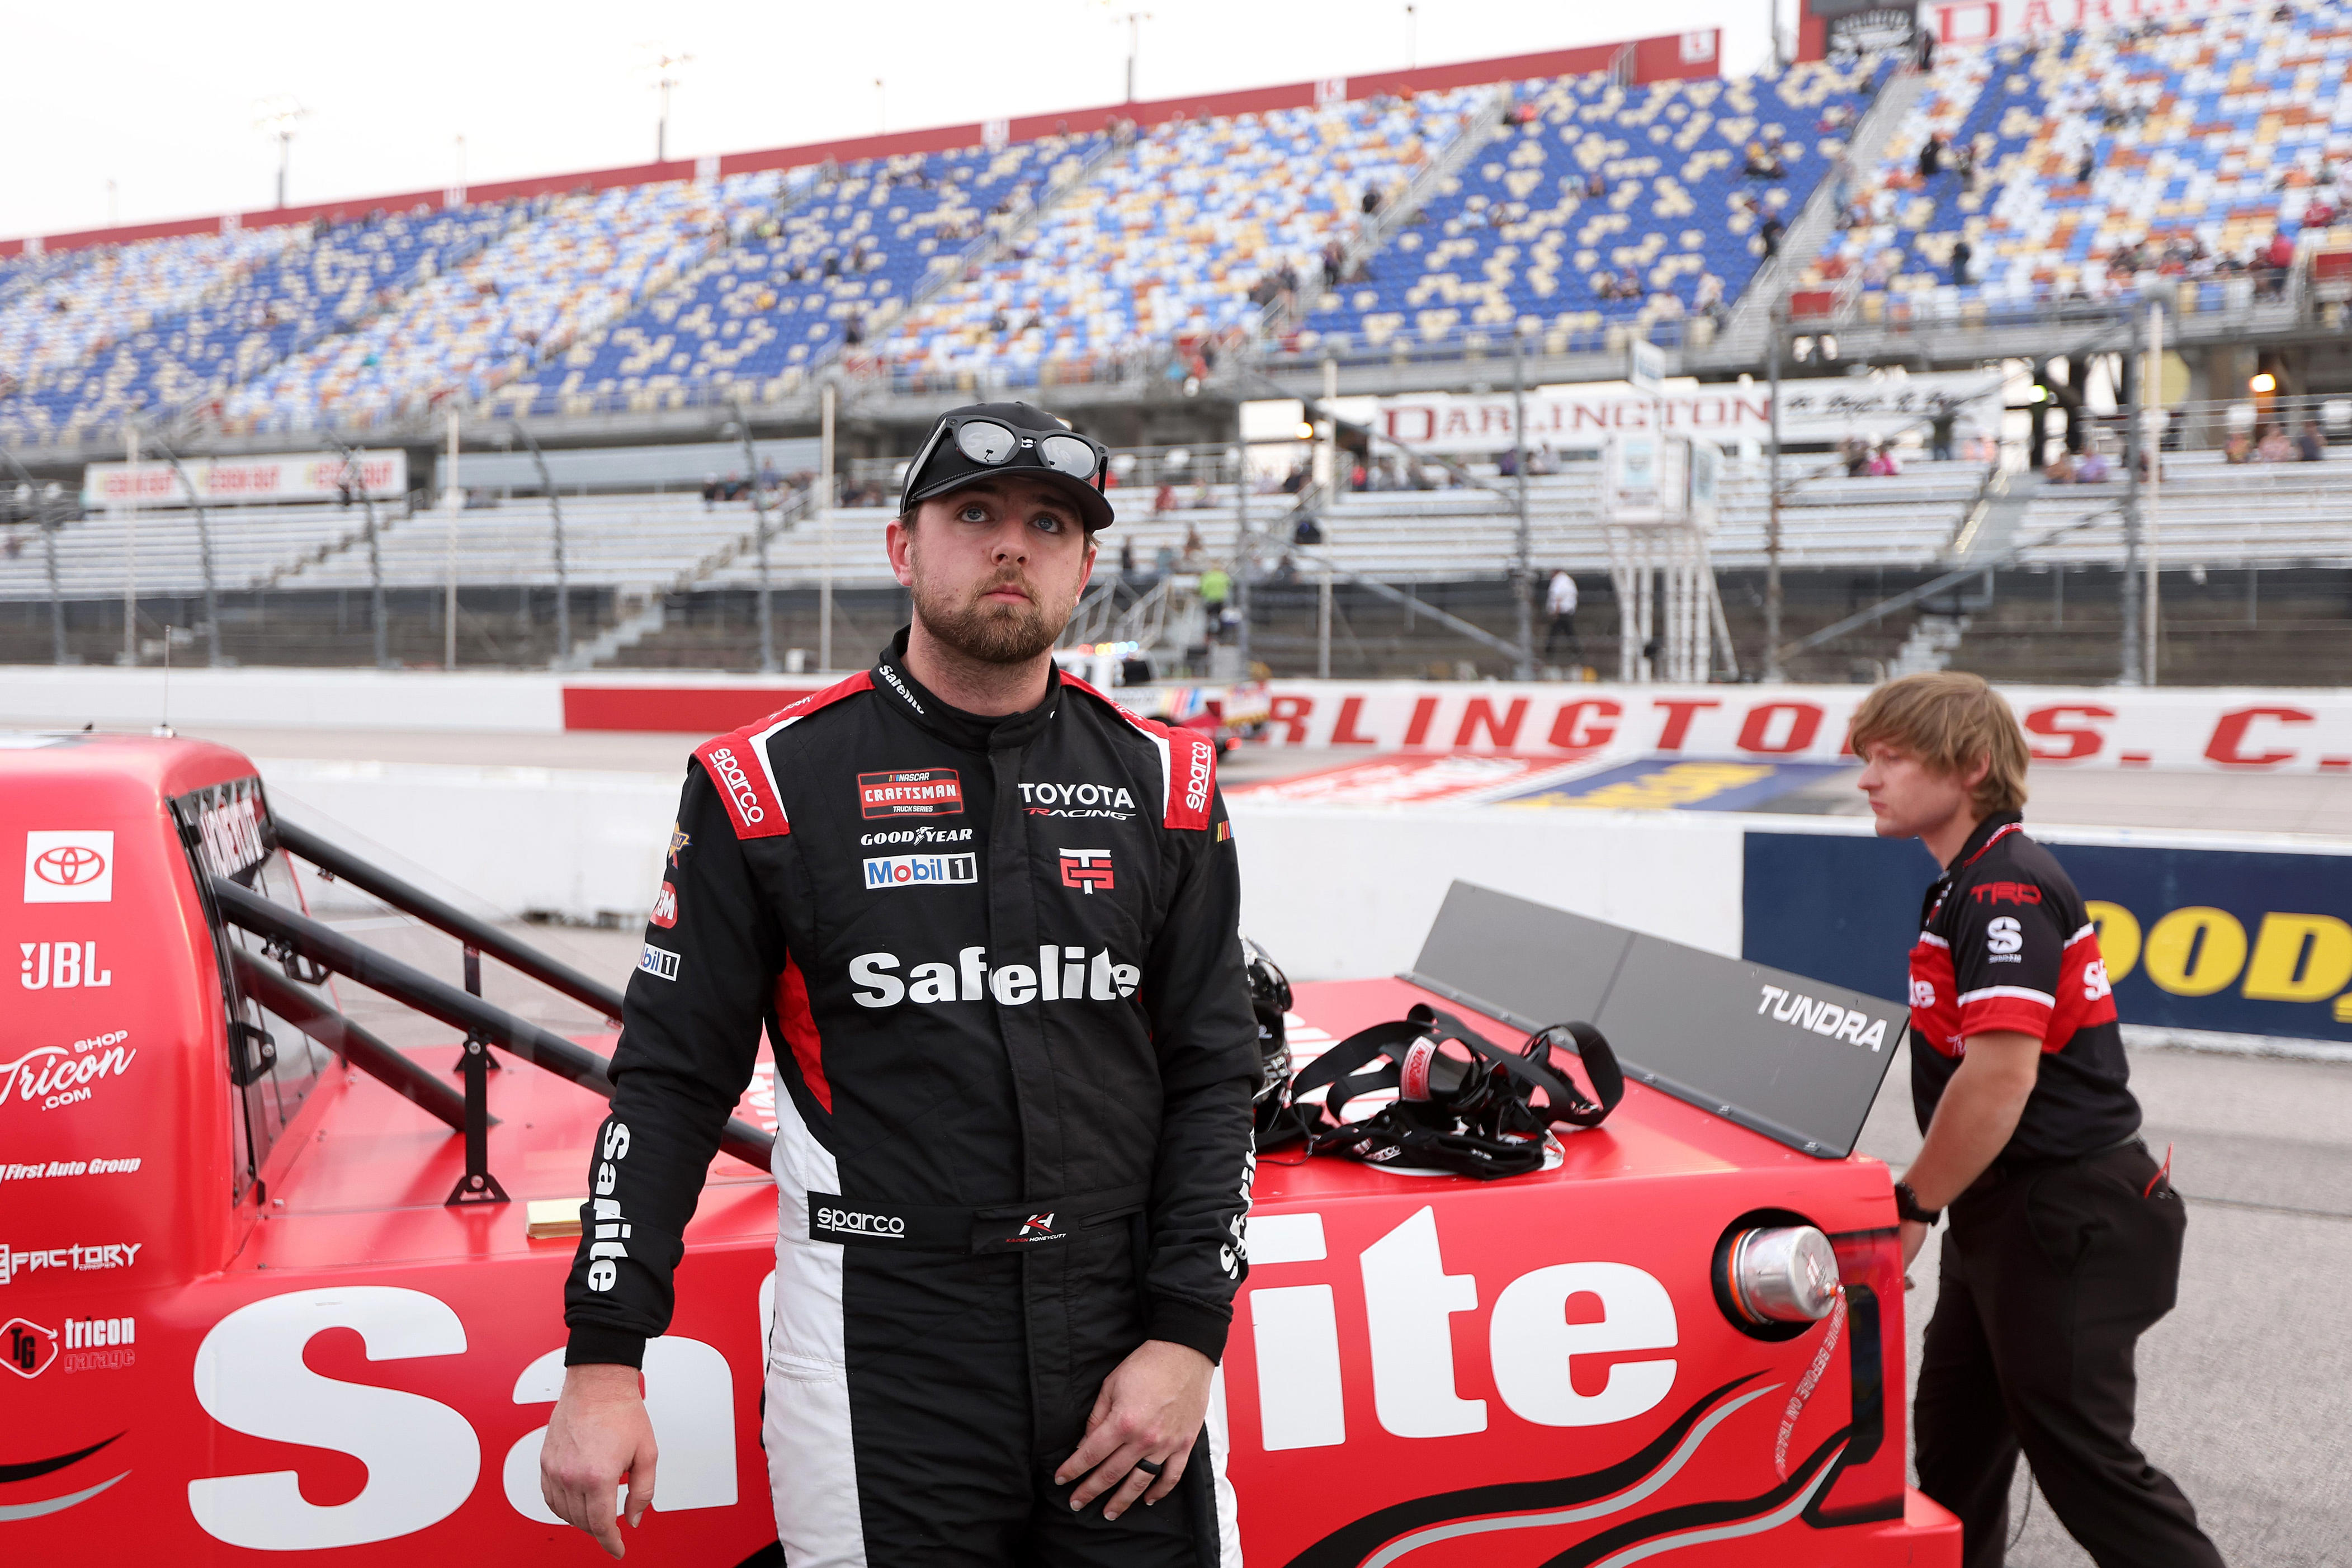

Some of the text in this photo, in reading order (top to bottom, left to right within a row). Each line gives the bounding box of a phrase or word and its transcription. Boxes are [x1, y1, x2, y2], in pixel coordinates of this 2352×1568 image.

[1380, 395, 1772, 445] DARLINGTON
[710, 747, 764, 824] sparco
[899, 772, 930, 782] NASCAR
[1185, 741, 1210, 810] sparco
[865, 784, 956, 802] CRAFTSMAN
[1018, 782, 1136, 809] TOYOTA
[1022, 807, 1136, 820] RACING
[867, 859, 965, 885] Mobil 1
[1970, 881, 2043, 906] TRD
[641, 947, 660, 971] bil
[2085, 900, 2352, 1003] OOD
[20, 941, 112, 990] JBL
[849, 944, 1141, 1008] Safelite
[1758, 984, 1887, 1052] TUNDRA
[74, 1029, 128, 1053] SHOP
[0, 1045, 137, 1106] Tricon
[41, 1086, 92, 1112] .COM
[5, 1156, 142, 1181] First Auto Group
[817, 1207, 905, 1235] sparco
[1029, 1232, 1066, 1242] HONEYCUTT
[11, 1242, 143, 1277] FACTORY
[65, 1316, 135, 1349] tricon
[64, 1348, 135, 1375] garage
[1774, 1296, 1846, 1467] REMOVE BEFORE ON TRACK
